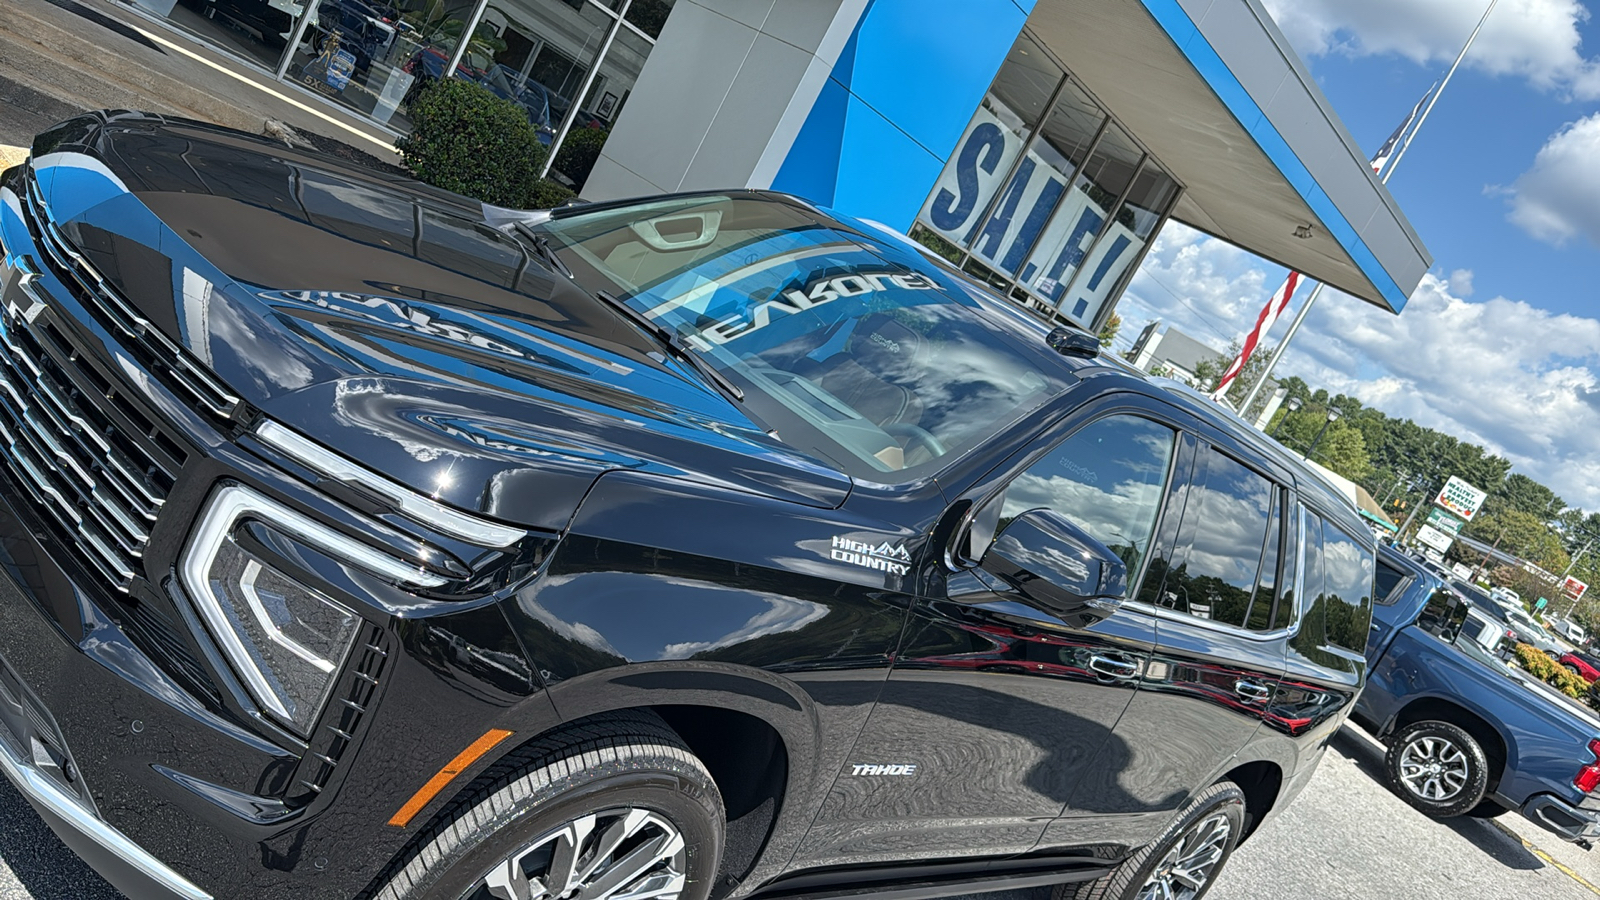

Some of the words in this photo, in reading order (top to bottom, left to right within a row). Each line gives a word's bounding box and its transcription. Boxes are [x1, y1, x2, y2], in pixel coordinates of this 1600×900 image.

[1447, 482, 1475, 499] HEALTHY
[1447, 489, 1476, 506] HARVEST
[1446, 494, 1476, 513] PRODUCE
[831, 535, 875, 555] HIGH
[830, 549, 911, 576] COUNTRY
[851, 763, 917, 776] TAHOE
